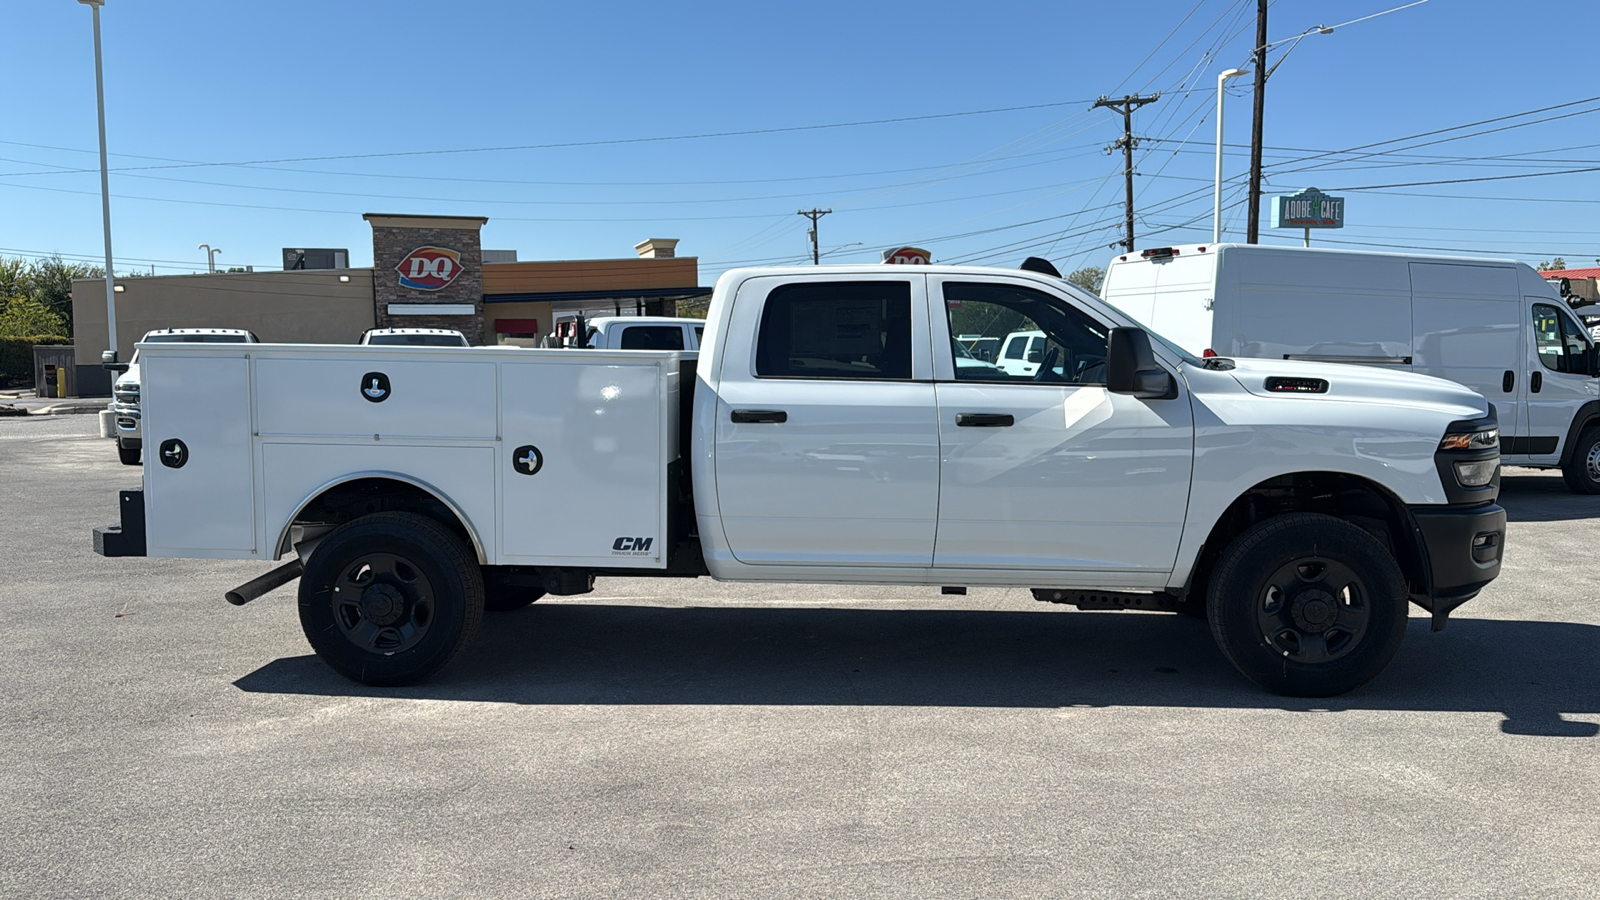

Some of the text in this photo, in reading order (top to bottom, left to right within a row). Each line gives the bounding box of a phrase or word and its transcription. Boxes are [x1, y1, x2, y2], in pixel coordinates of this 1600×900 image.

[1284, 200, 1340, 220] ADOBE CAFE
[408, 257, 453, 280] DQ
[613, 537, 653, 551] CM
